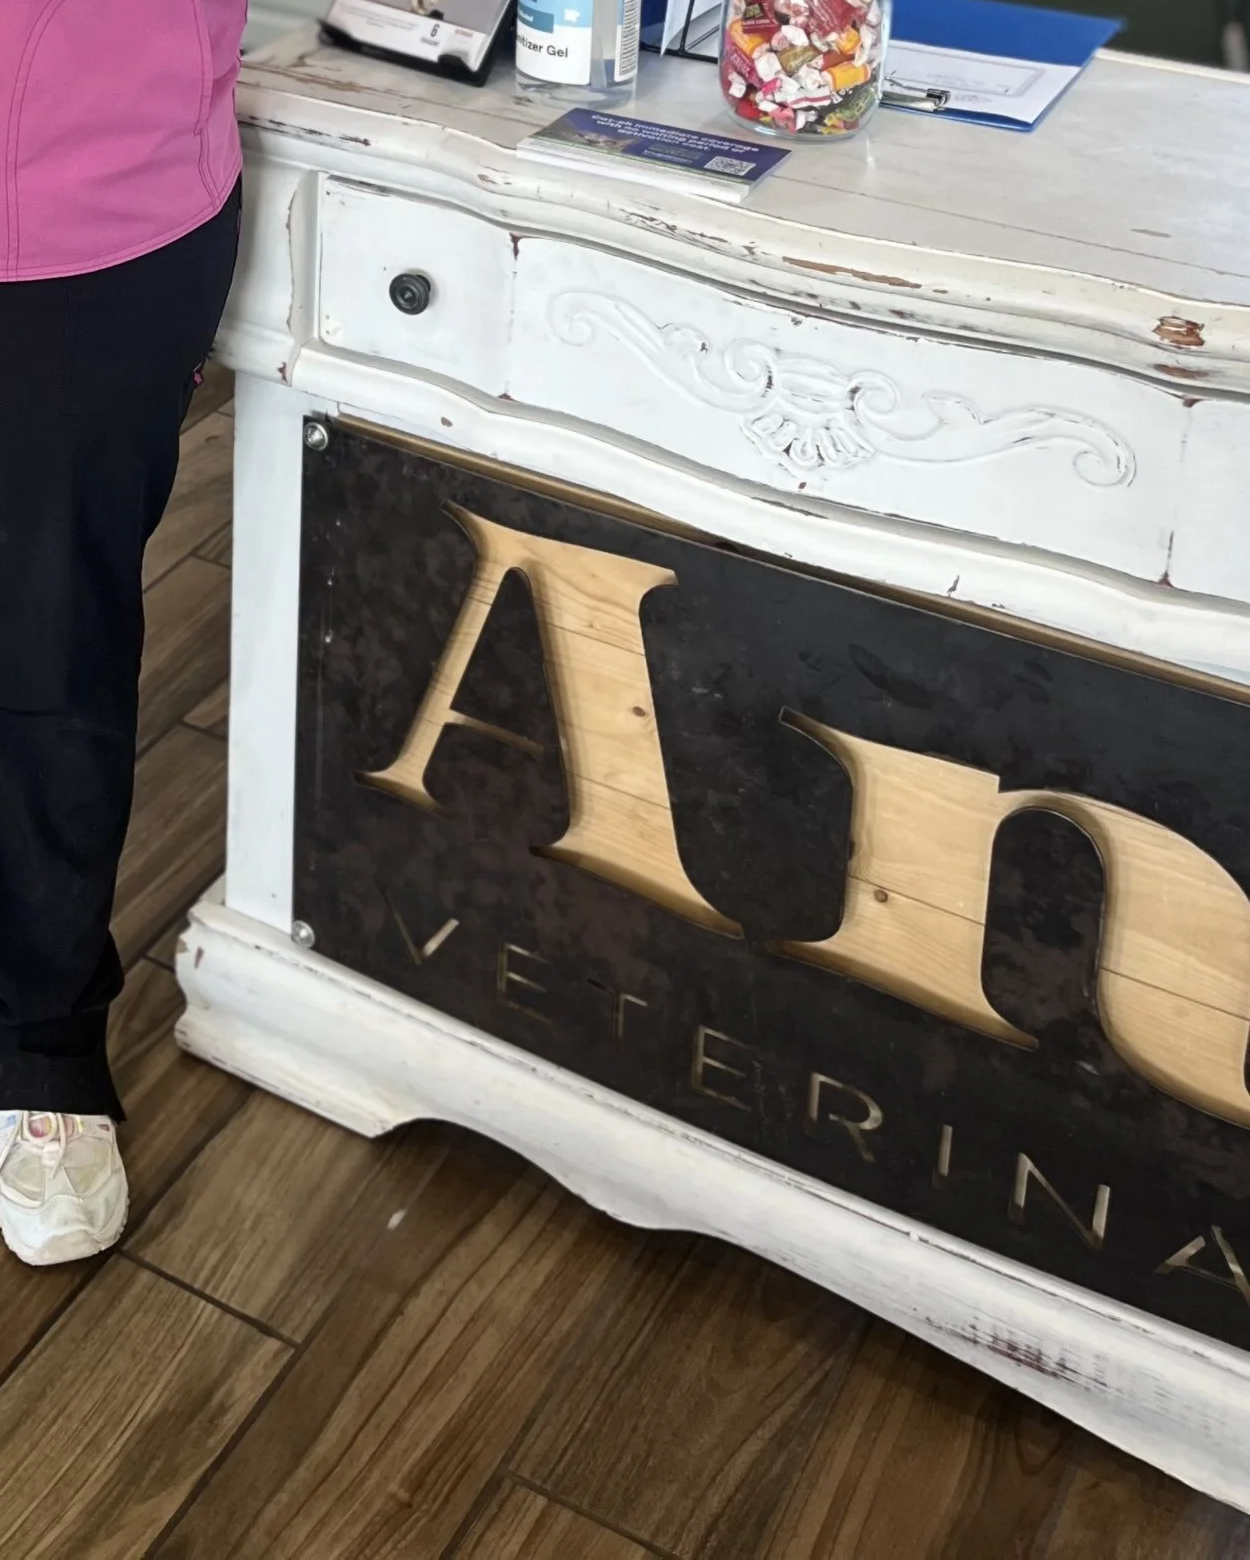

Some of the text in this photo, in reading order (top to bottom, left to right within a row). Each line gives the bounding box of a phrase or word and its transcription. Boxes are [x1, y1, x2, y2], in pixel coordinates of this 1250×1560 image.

[546, 45, 568, 58] Gel
[596, 119, 622, 129] with
[642, 129, 687, 142] waiting
[688, 139, 729, 151] period
[700, 137, 760, 153] coverage
[380, 886, 1250, 1308] VETERINA
